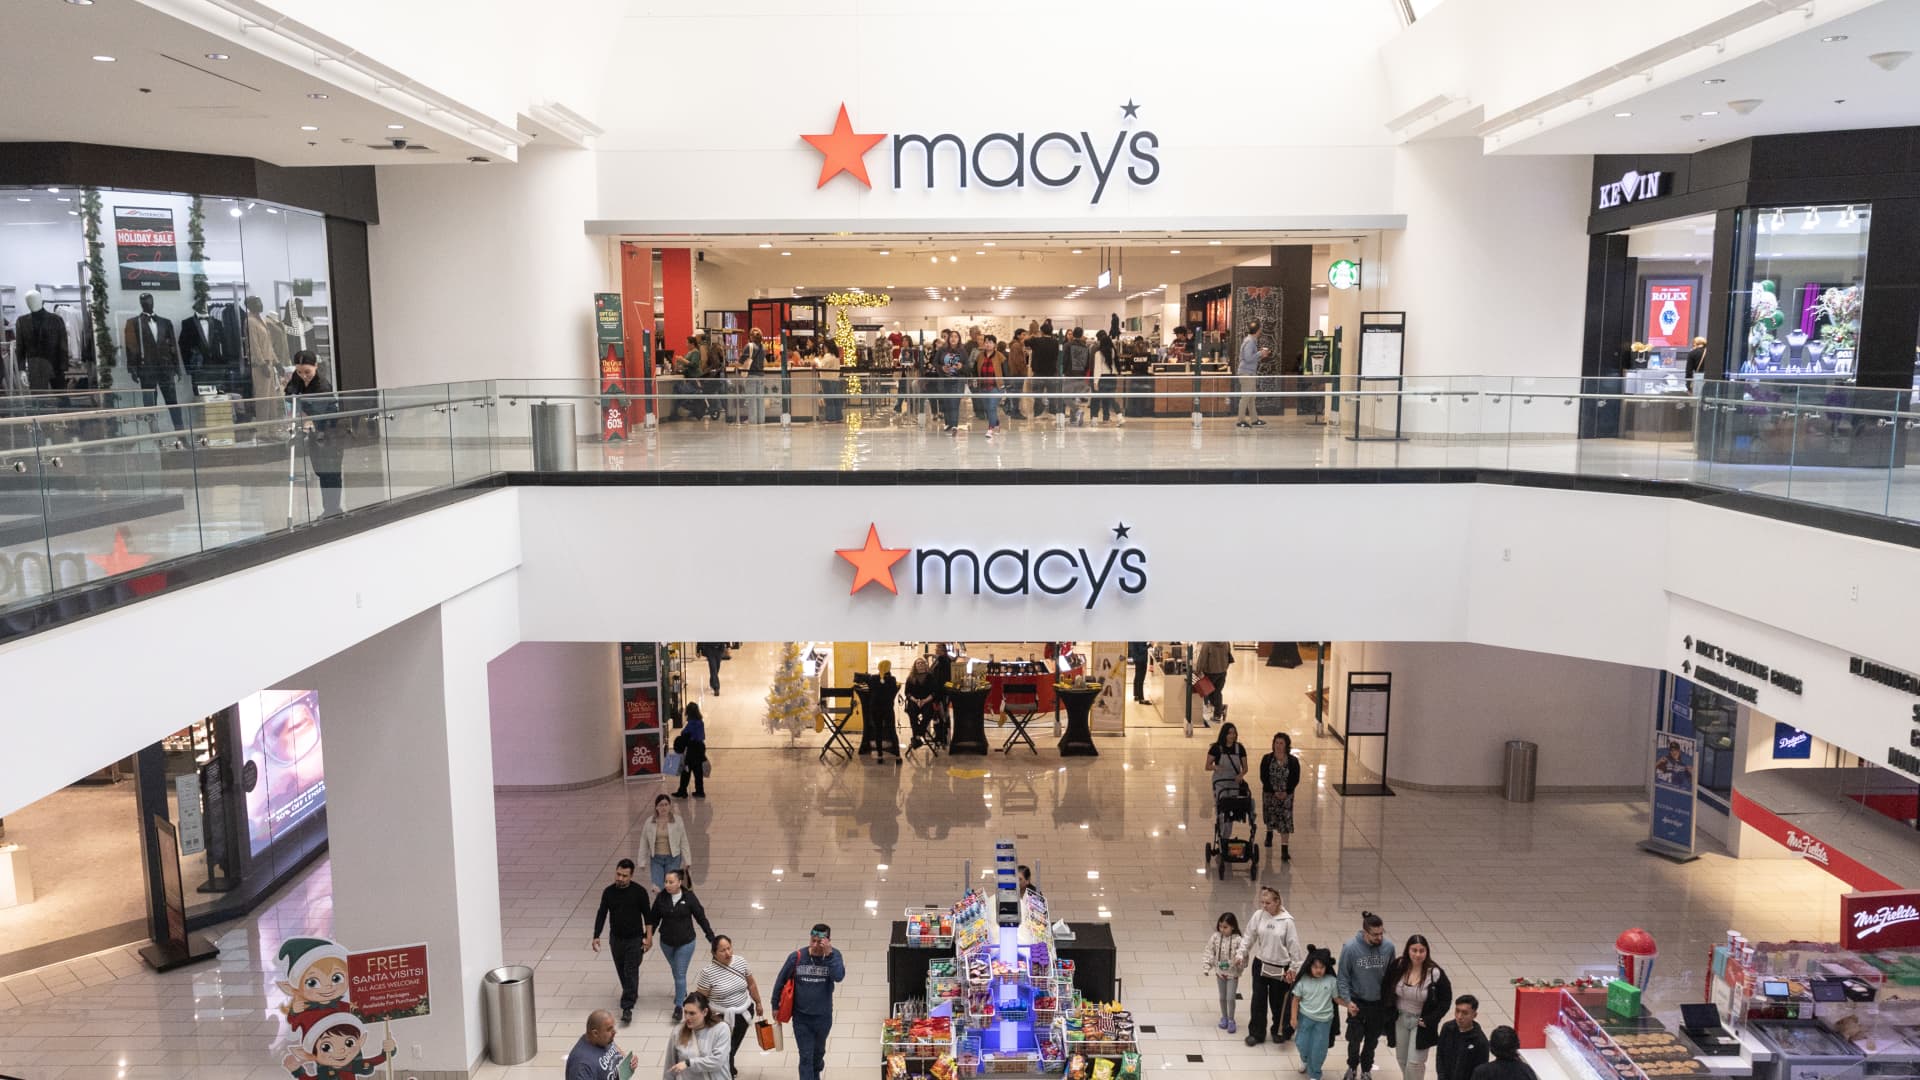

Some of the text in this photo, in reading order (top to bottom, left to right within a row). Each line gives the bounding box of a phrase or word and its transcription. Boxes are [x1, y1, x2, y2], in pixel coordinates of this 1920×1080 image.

[894, 97, 1160, 205] macy's
[1599, 170, 1661, 209] KEVIN
[118, 232, 173, 243] HOLIDAY SALE
[1652, 291, 1688, 301] ROLEX
[916, 521, 1148, 610] macy's
[632, 746, 652, 756] 30-
[367, 953, 409, 973] FREE
[352, 967, 424, 985] SANTA VISITS!
[357, 978, 420, 993] ALL AGES WELCOME
